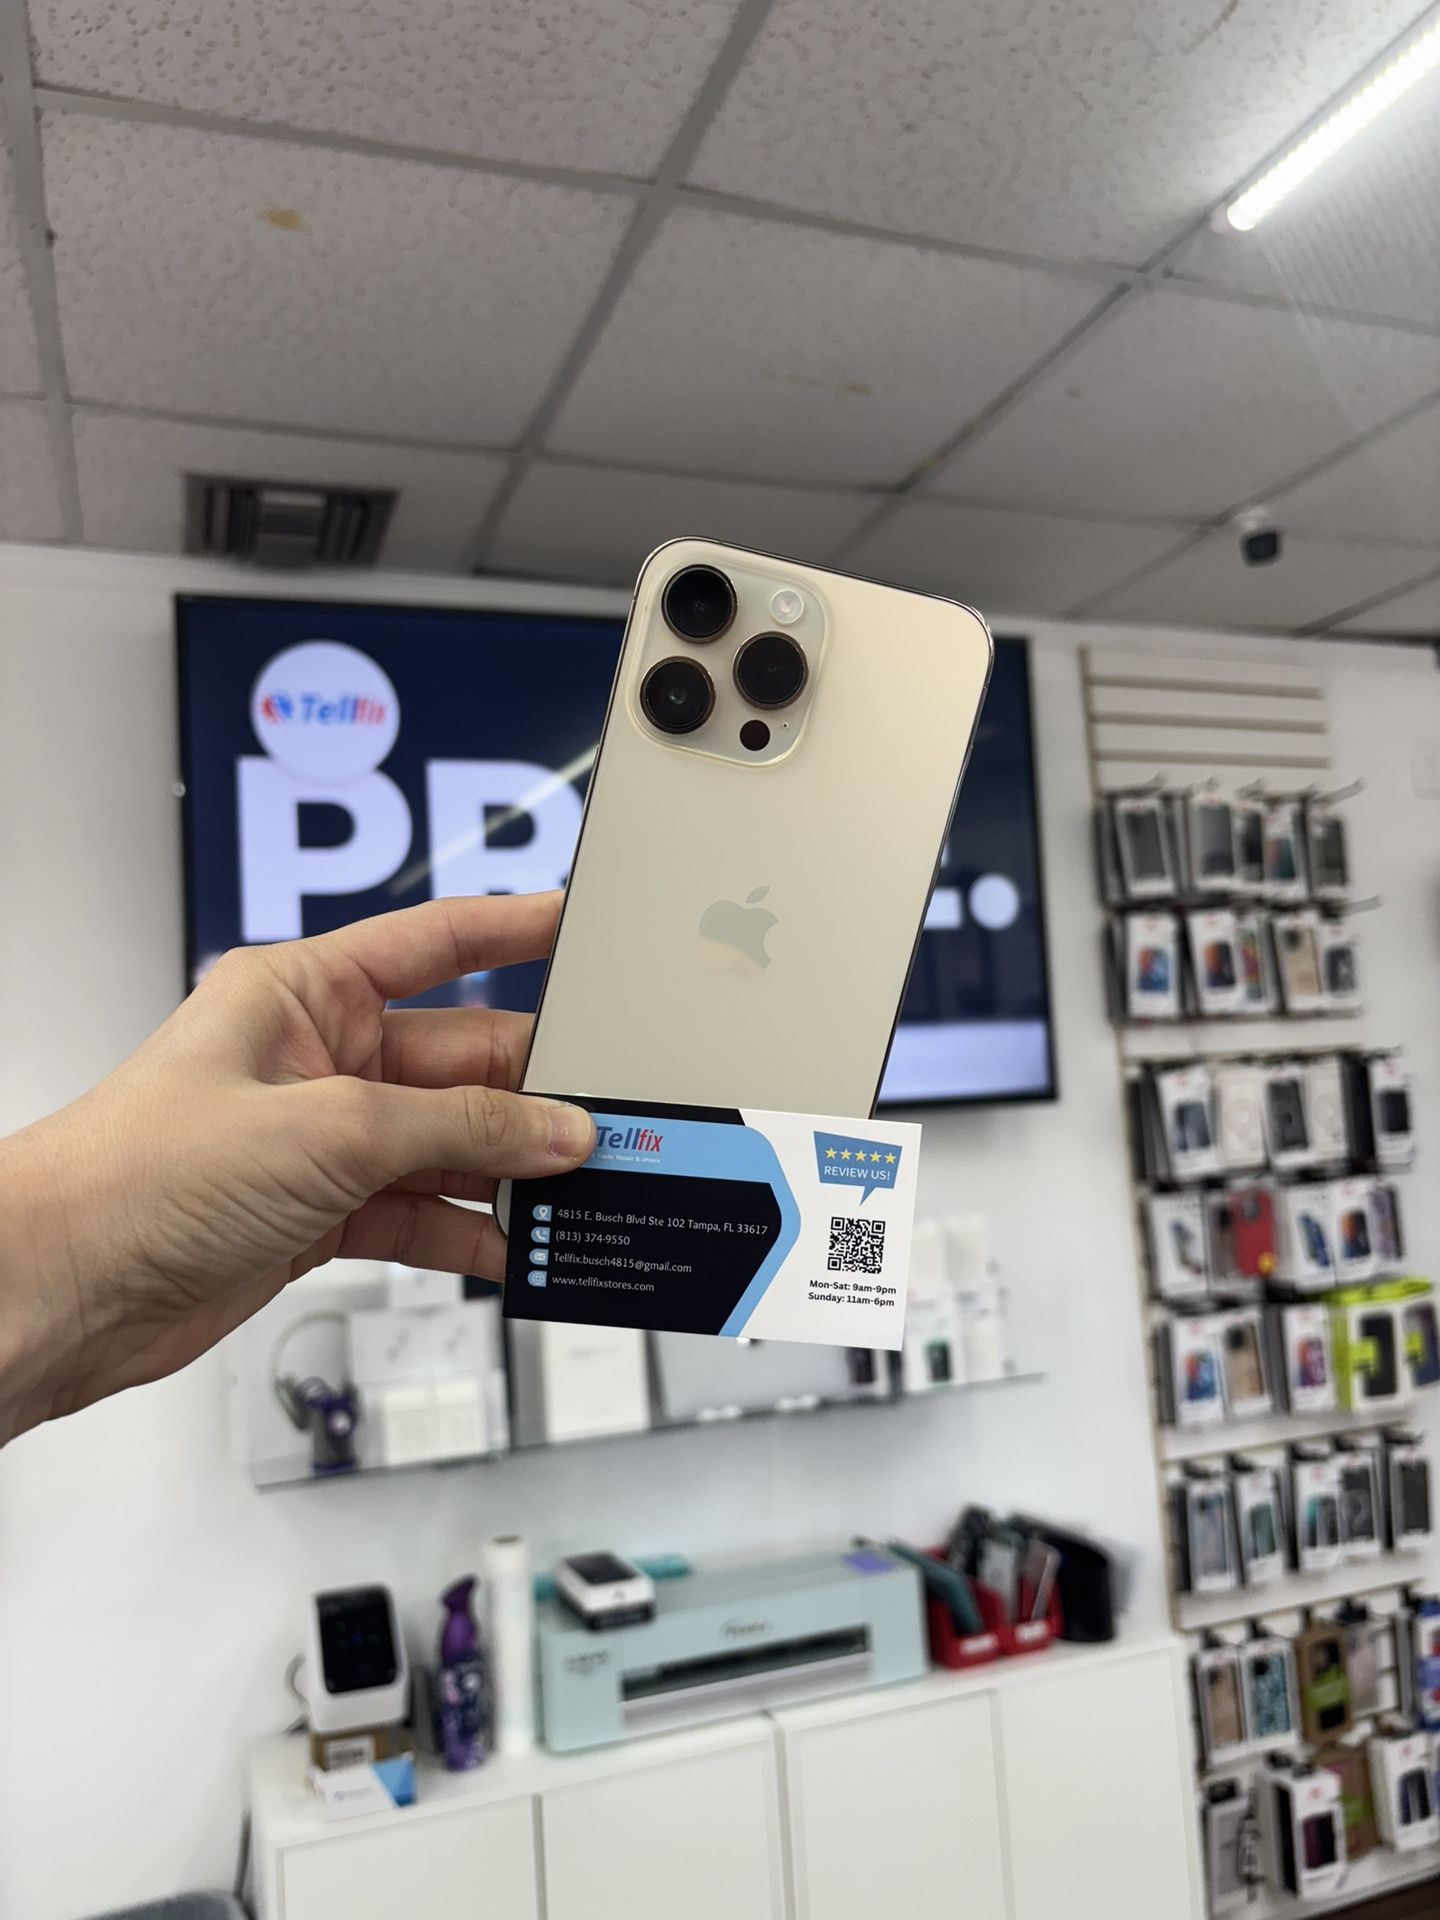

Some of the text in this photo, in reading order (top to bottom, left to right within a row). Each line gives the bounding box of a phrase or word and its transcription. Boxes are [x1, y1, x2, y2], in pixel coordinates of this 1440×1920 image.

[300, 694, 387, 726] Tellfix
[597, 1125, 664, 1152] Tellfix
[824, 1166, 890, 1180] REVIEW US!
[557, 1209, 768, 1236] 4815 E. Busch Blvd Ste 102 Tampa, FL 33617
[555, 1230, 631, 1246] (813) 374-9550
[554, 1252, 692, 1273] Tellfix.busch4815@gmail.com
[552, 1275, 655, 1292] www.tellfixstores.com
[809, 1280, 897, 1295] Mon-Sat: 9am-9pm
[808, 1292, 895, 1307] Sunday: 11am-6pm
